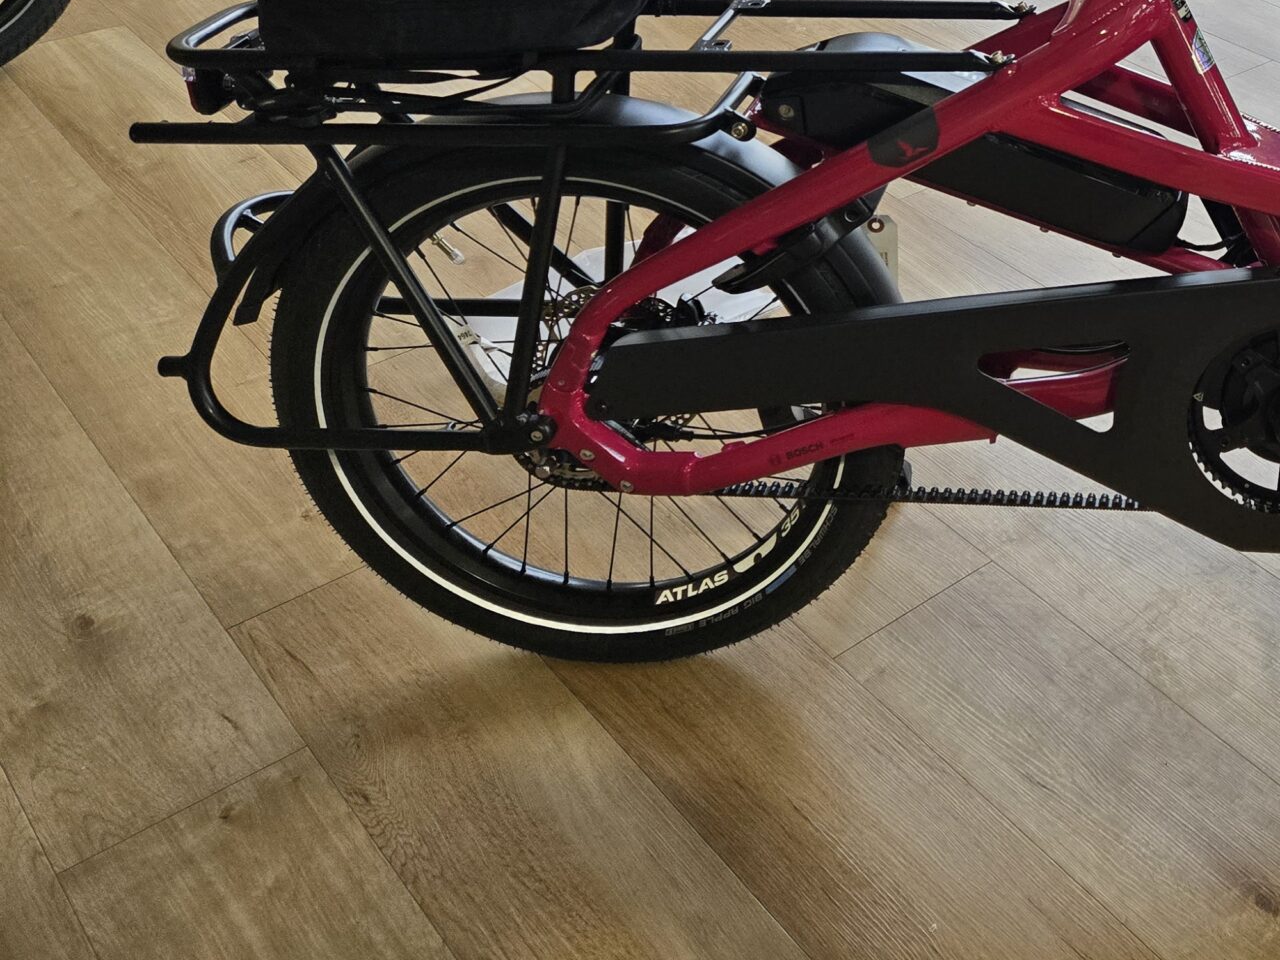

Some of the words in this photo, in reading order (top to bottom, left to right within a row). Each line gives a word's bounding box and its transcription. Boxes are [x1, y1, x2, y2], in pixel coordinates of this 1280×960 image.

[785, 440, 825, 460] BOSCH
[780, 506, 801, 538] 35
[797, 505, 838, 567] SCHWALBE
[655, 569, 730, 606] ATLAS
[743, 594, 763, 610] BIG
[698, 605, 740, 628] APPLE
